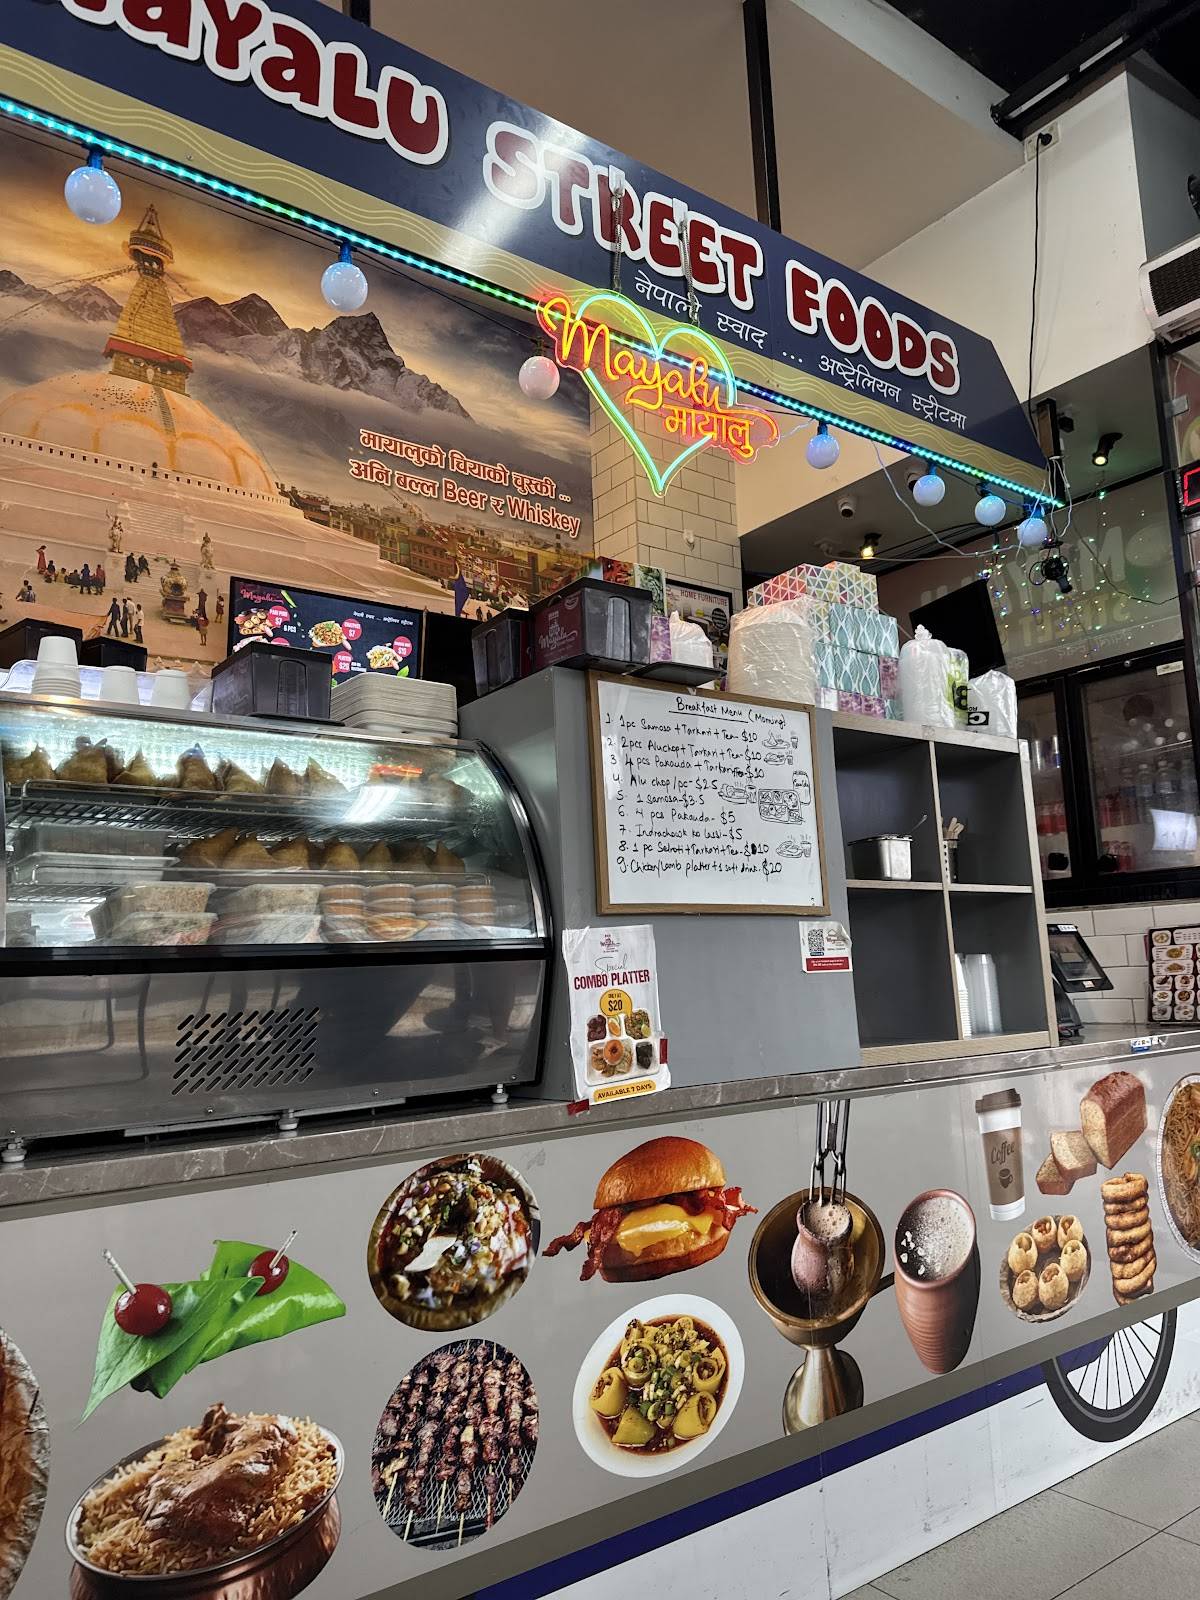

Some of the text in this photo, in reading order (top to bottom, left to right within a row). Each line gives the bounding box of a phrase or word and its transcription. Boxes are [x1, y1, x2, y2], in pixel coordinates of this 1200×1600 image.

[483, 121, 763, 311] STREET
[785, 258, 960, 395] FOODS
[716, 311, 768, 349] स्वाद
[543, 297, 757, 416] Mayalu
[662, 404, 755, 458] मायालु
[360, 428, 446, 468] मायालुको
[449, 449, 509, 486] चियाको
[350, 458, 391, 486] अनि
[442, 477, 488, 510] Beer
[506, 495, 581, 539] Whiskey
[676, 696, 717, 715] Breakfast
[721, 706, 742, 717] Menu
[720, 806, 736, 827] $5
[573, 969, 650, 991] COMBO PLATTER
[608, 999, 623, 1012] $20
[597, 1088, 631, 1100] AVAILABLE
[636, 1083, 653, 1092] DAYS
[990, 1140, 1015, 1165] Coffee
